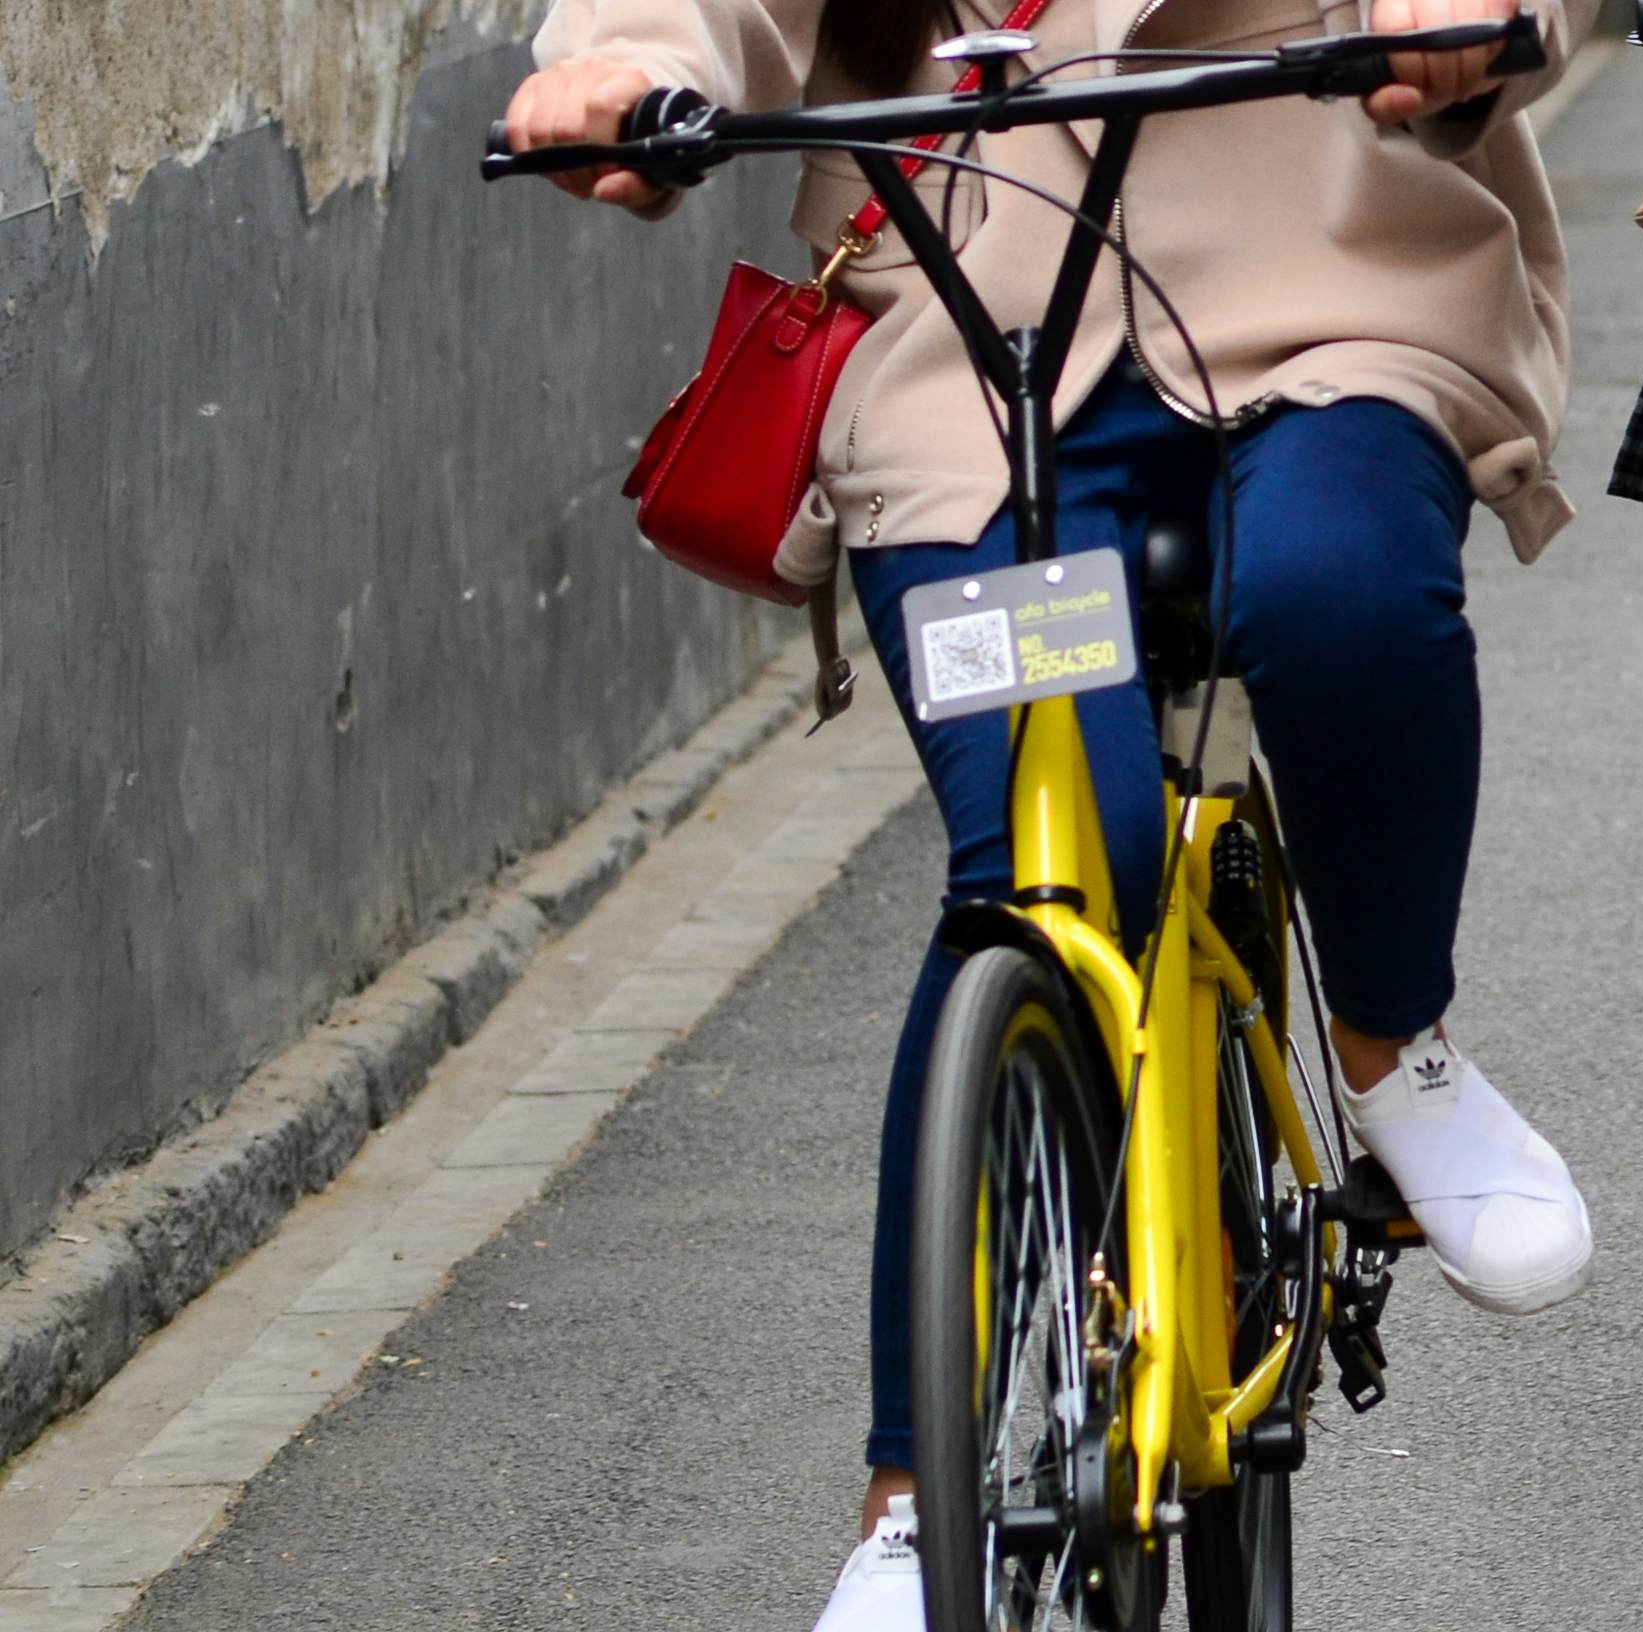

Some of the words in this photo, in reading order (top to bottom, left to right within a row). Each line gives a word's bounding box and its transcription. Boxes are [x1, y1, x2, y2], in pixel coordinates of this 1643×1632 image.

[1014, 601, 1045, 621] ofo
[1048, 589, 1111, 615] bicycle
[1022, 640, 1117, 684] 2554350
[1418, 1079, 1450, 1092] adidas
